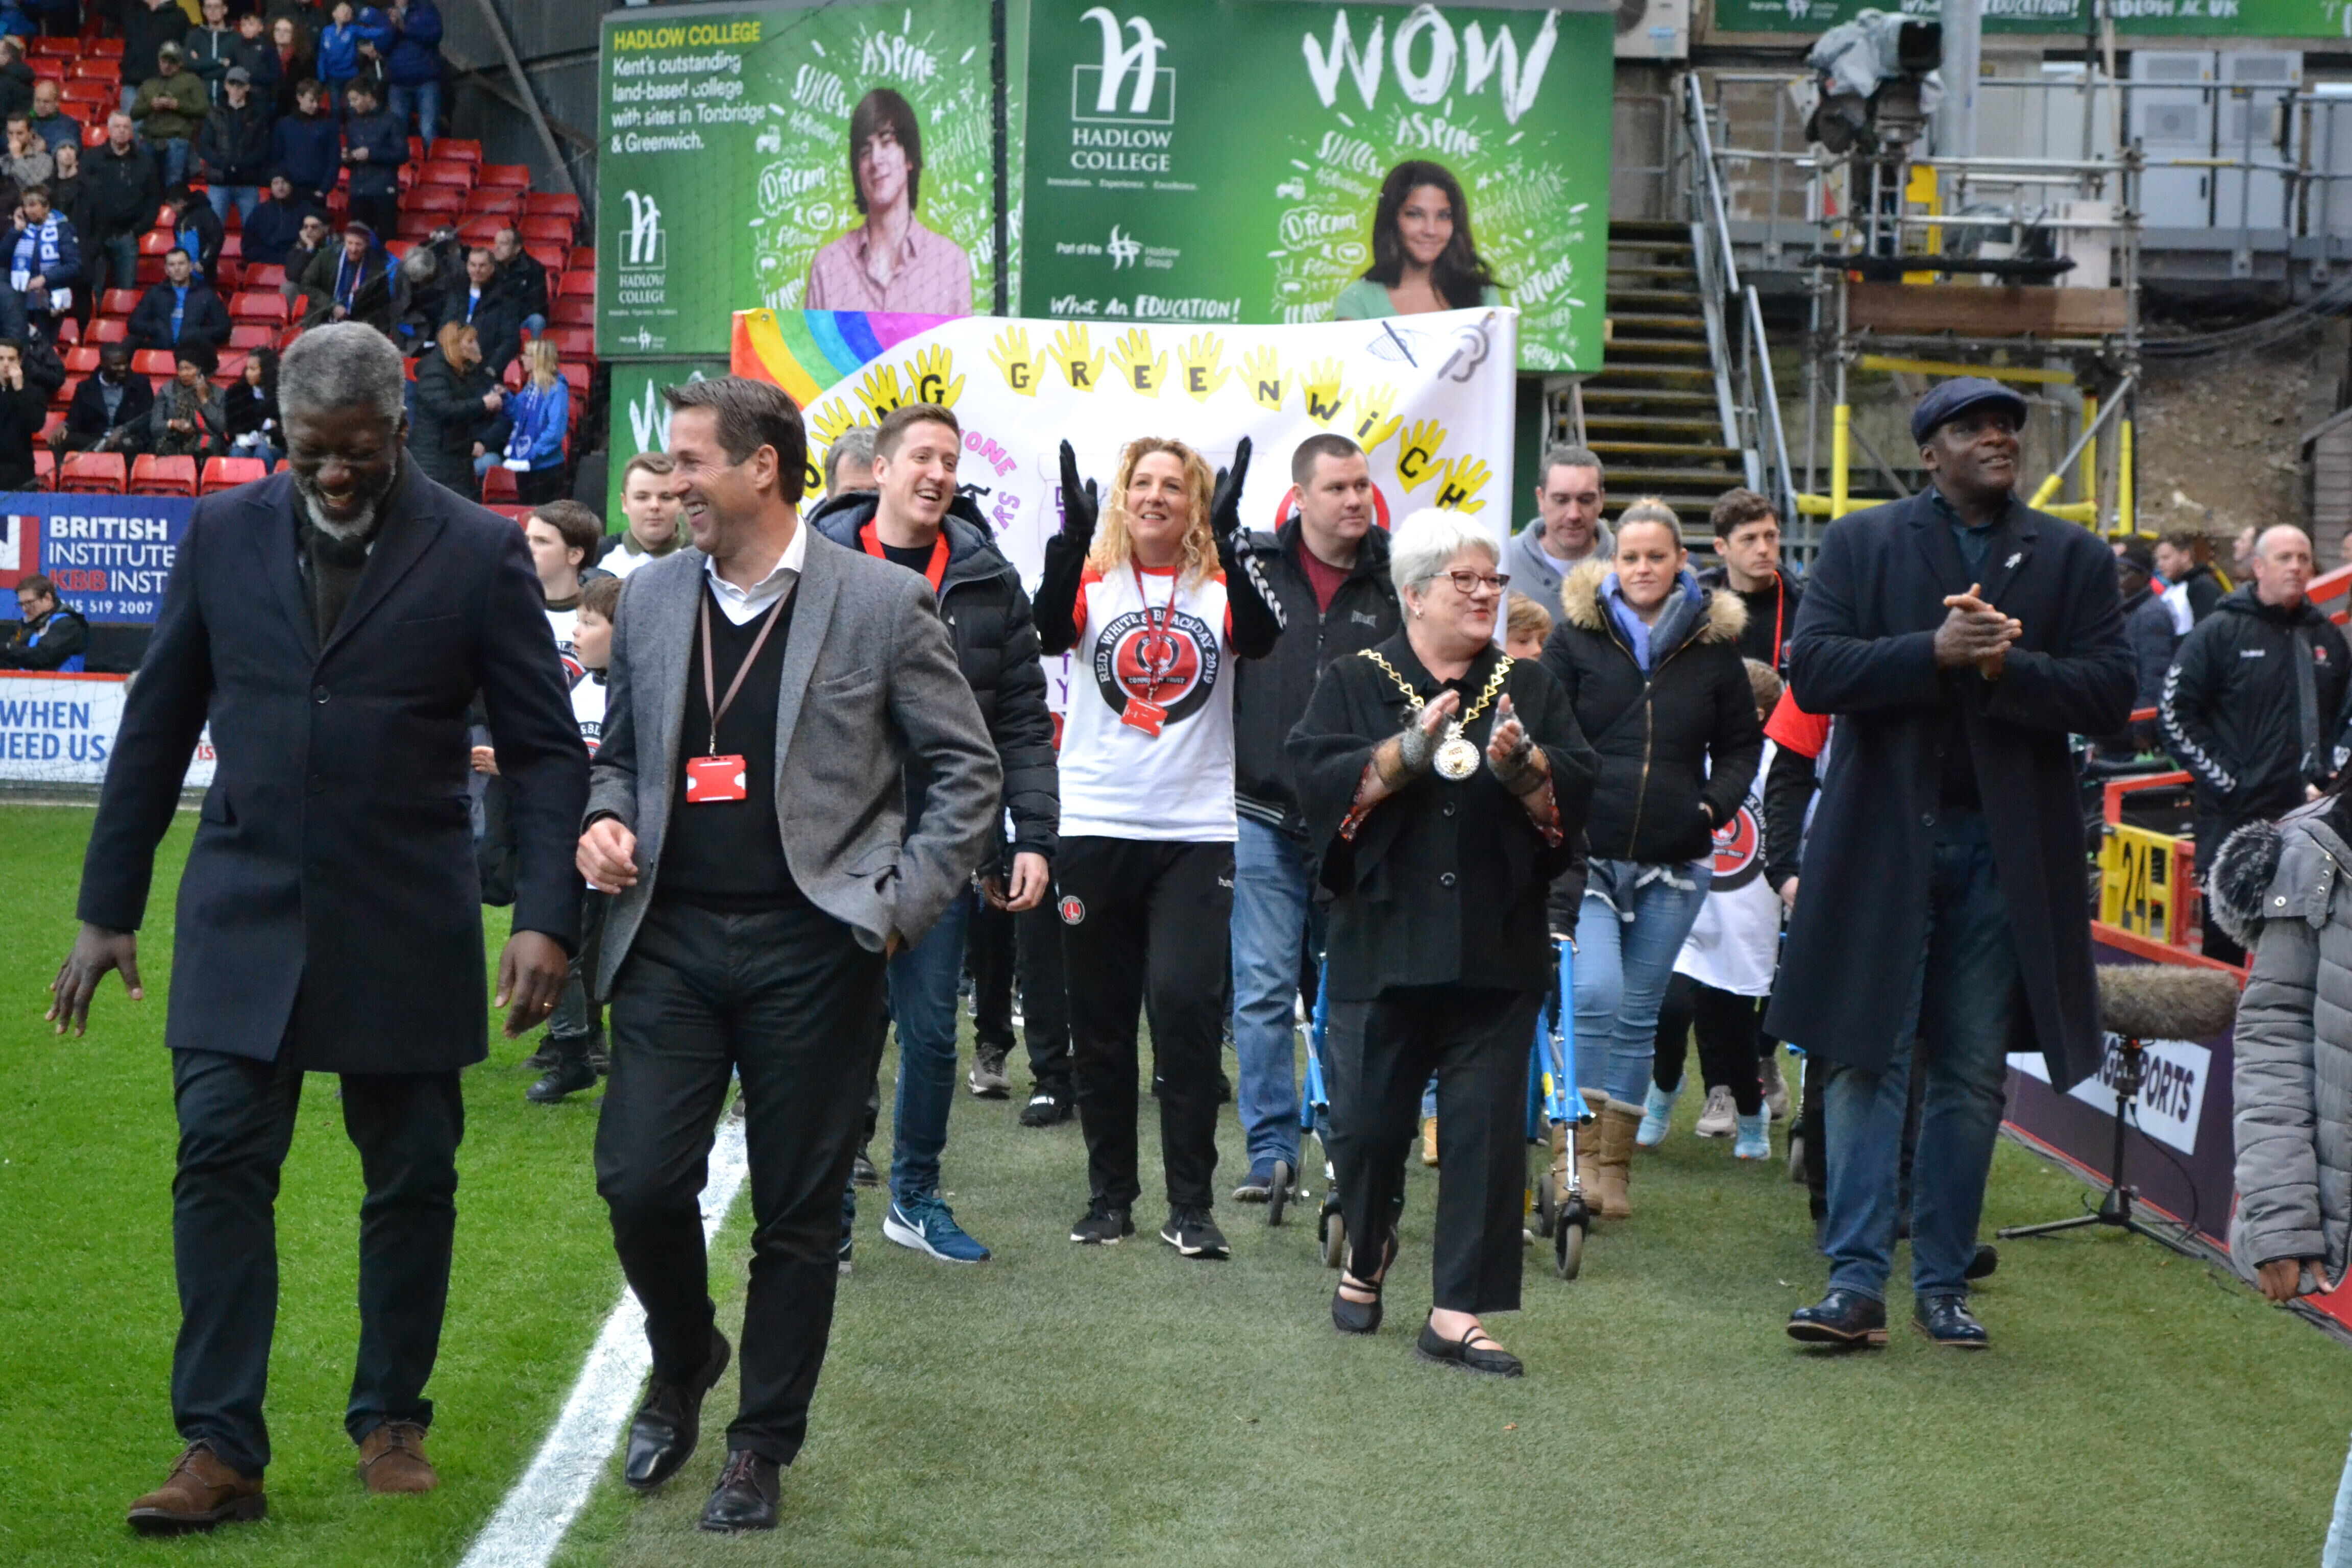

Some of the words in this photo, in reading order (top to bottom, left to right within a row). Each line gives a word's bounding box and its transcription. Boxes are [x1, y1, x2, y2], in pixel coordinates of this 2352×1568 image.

[614, 27, 686, 50] HADLOW
[689, 21, 762, 45] COLLEGE
[613, 54, 656, 76] Kent's
[658, 50, 742, 75] outstanding
[860, 30, 938, 86] ASPIRE
[1303, 3, 1561, 126] WOW
[613, 78, 688, 102] land-based
[691, 76, 744, 101] college
[611, 106, 641, 127] with
[644, 105, 676, 126] sites
[679, 103, 692, 124] in
[696, 101, 766, 125] Tonbridge
[611, 134, 622, 153] &
[625, 129, 704, 153] Greenwich.
[1072, 127, 1173, 149] HADLOW
[1395, 112, 1481, 159] ASPIRE
[1070, 151, 1171, 173] COLLEGE
[619, 274, 666, 288] HADLOW
[618, 289, 666, 304] COLLEGE
[1134, 293, 1241, 324] EDUCATION!
[50, 515, 168, 541] BRITISH
[48, 542, 177, 568] INSTITUTE
[49, 568, 108, 592] KBB
[90, 599, 113, 614] 519
[119, 600, 153, 615] 2007
[1100, 614, 1139, 646] WHITE
[1191, 622, 1215, 649] DAY
[1202, 652, 1217, 684] 2019
[0, 700, 90, 729] WHEN
[69, 733, 107, 763] US
[2137, 1049, 2194, 1123] PORTS
